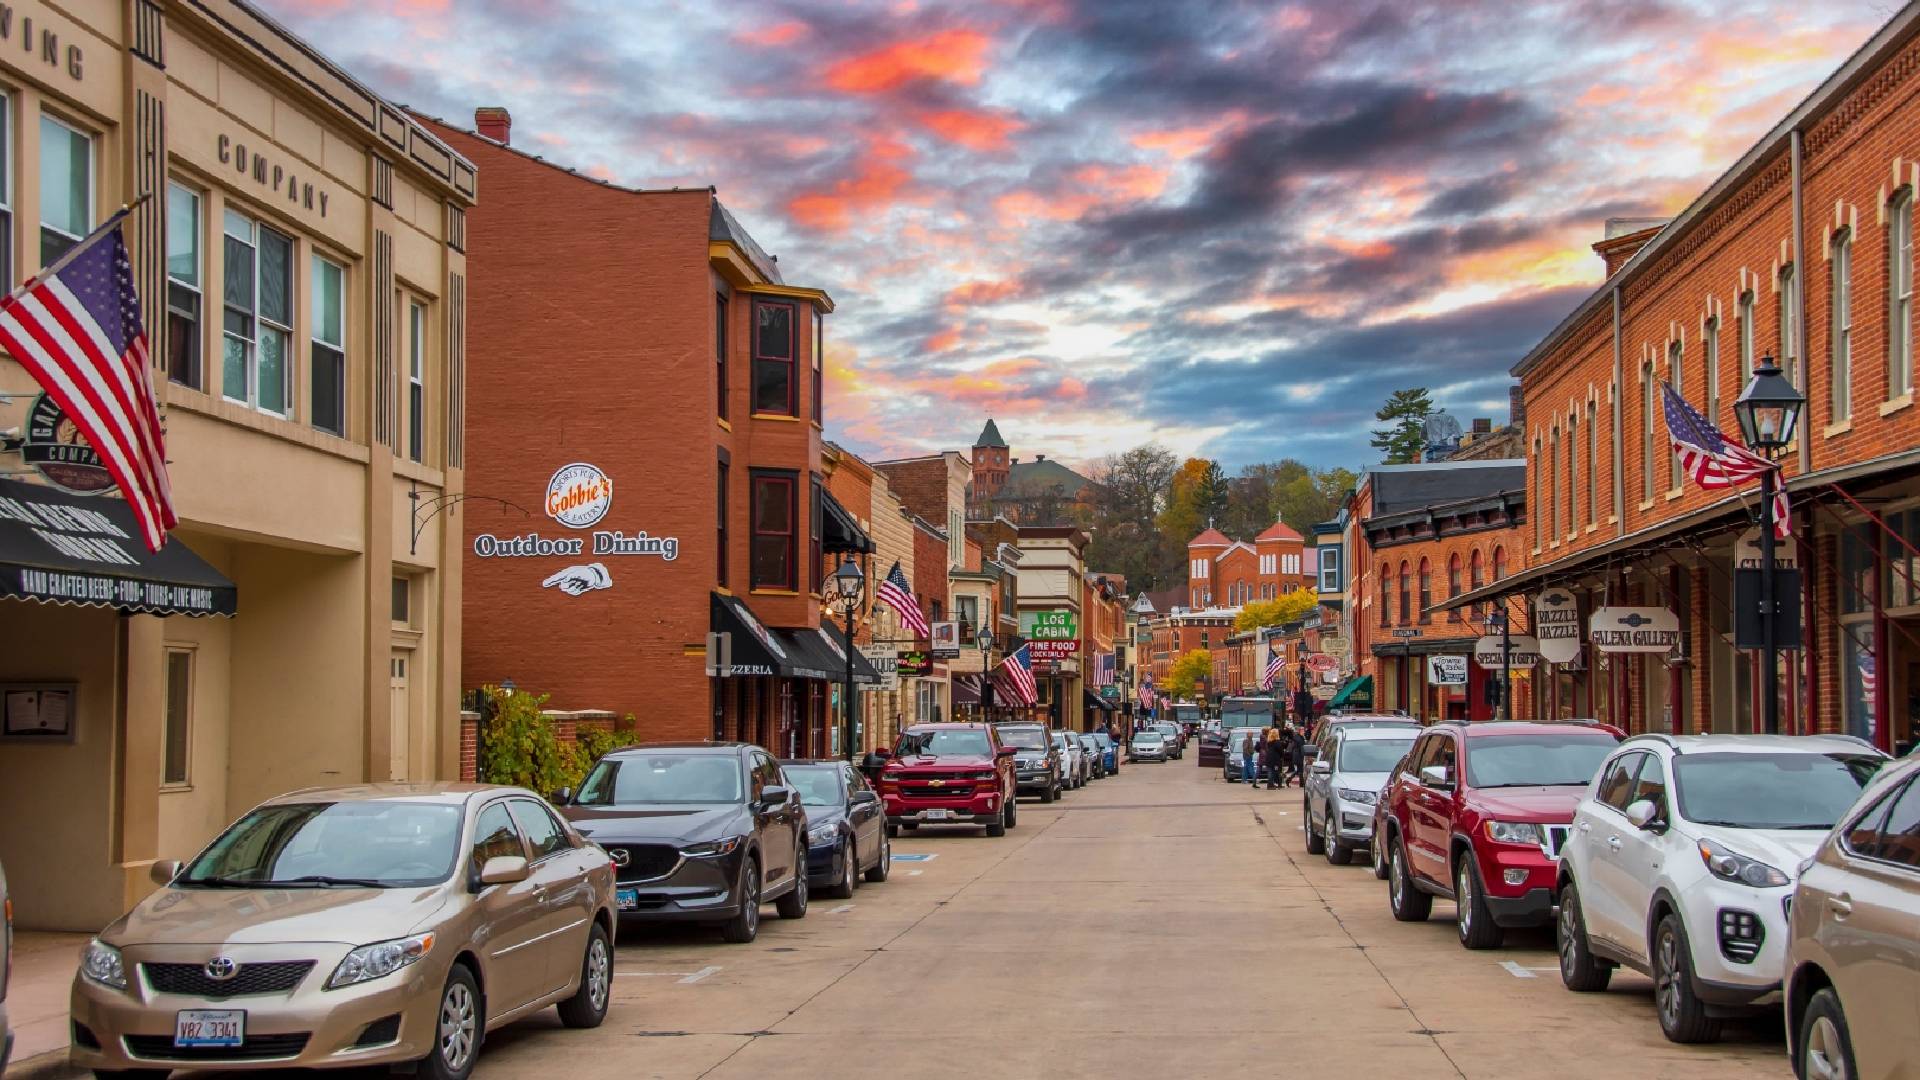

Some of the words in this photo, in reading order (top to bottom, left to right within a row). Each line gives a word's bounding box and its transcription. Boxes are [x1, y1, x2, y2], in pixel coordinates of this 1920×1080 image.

[218, 134, 329, 218] COMPANY
[49, 446, 98, 465] COMPA
[547, 478, 610, 515] Gobbie's
[475, 533, 583, 557] Outdoor
[592, 531, 679, 560] Dining
[22, 568, 47, 594] HAND
[49, 572, 88, 598] CRAFTED
[120, 580, 140, 602] FOOD
[1043, 614, 1065, 625] LOG
[1036, 626, 1070, 637] CABIN
[1539, 624, 1578, 639] DAZZLE
[1592, 630, 1632, 646] GALENA
[1633, 630, 1679, 646] GALLERY
[1029, 641, 1049, 651] FINE
[1052, 641, 1075, 651] FOOD
[730, 664, 773, 675] ZZERIA
[210, 1022, 238, 1039] 3341
